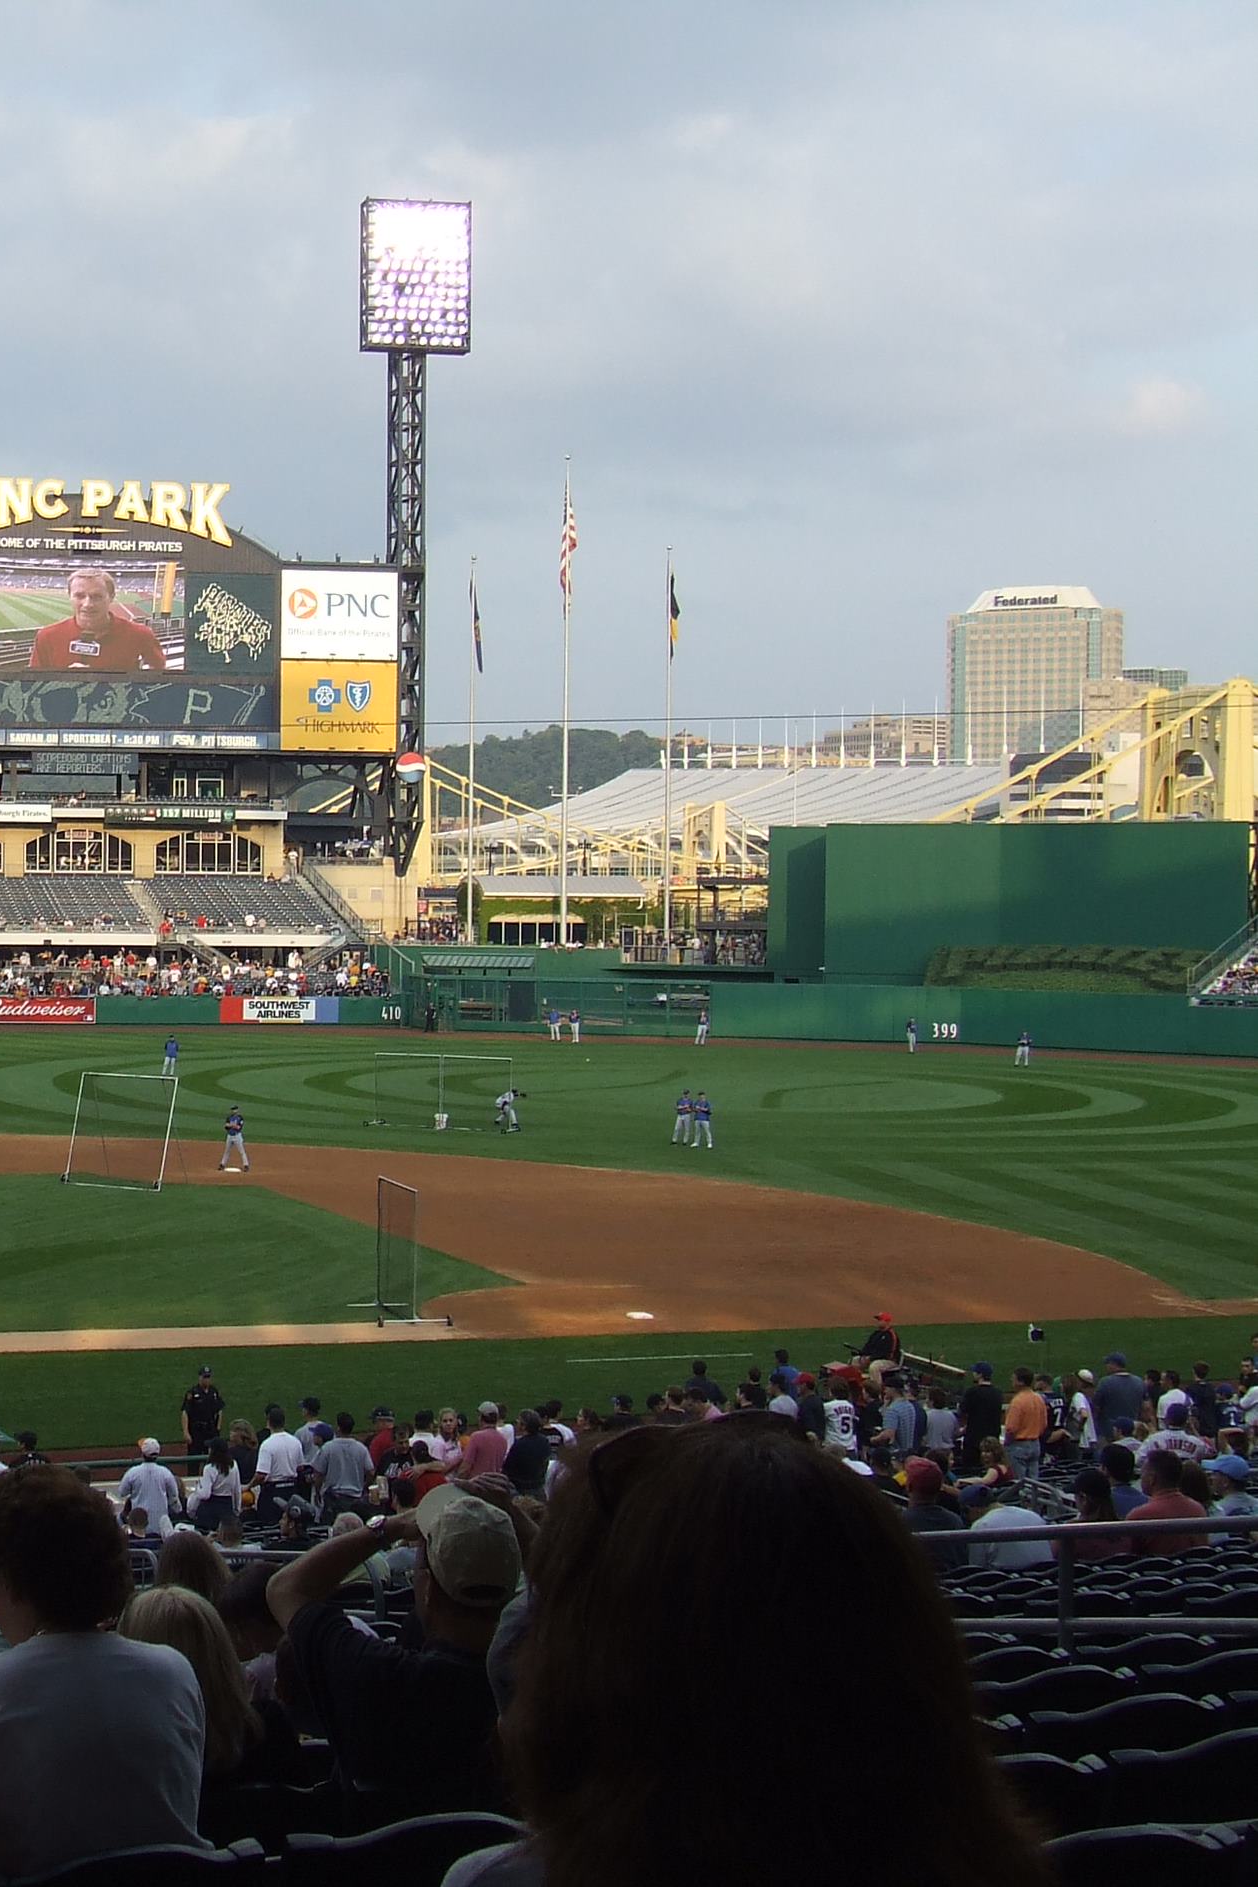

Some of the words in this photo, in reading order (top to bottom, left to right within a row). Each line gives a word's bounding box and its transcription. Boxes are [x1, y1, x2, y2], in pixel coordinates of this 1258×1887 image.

[81, 479, 232, 547] PARK
[25, 537, 38, 548] OF
[42, 538, 65, 549] THE
[67, 538, 137, 551] PITTSBURGH
[138, 540, 183, 552] PIRATES
[325, 593, 390, 618] PNC
[993, 594, 1058, 607] Federated
[288, 627, 315, 637] Official
[317, 628, 336, 637] Bank
[339, 629, 347, 637] of
[348, 629, 361, 637] the
[363, 629, 390, 638] Pirates
[46, 734, 59, 744] ON
[63, 733, 117, 745] SPORTSBEAT
[145, 735, 160, 745] PM
[172, 734, 196, 746] FSN
[36, 753, 87, 763] SCOREBOARD
[91, 754, 132, 763] CAPTIONS
[112, 764, 130, 774] INC.
[182, 808, 221, 818] MILLION
[248, 1001, 310, 1010] SOUTHWEST
[256, 1010, 301, 1019] AIRLINES
[381, 1006, 401, 1020] 410
[932, 1022, 958, 1039] 399
[841, 1416, 851, 1434] 5
